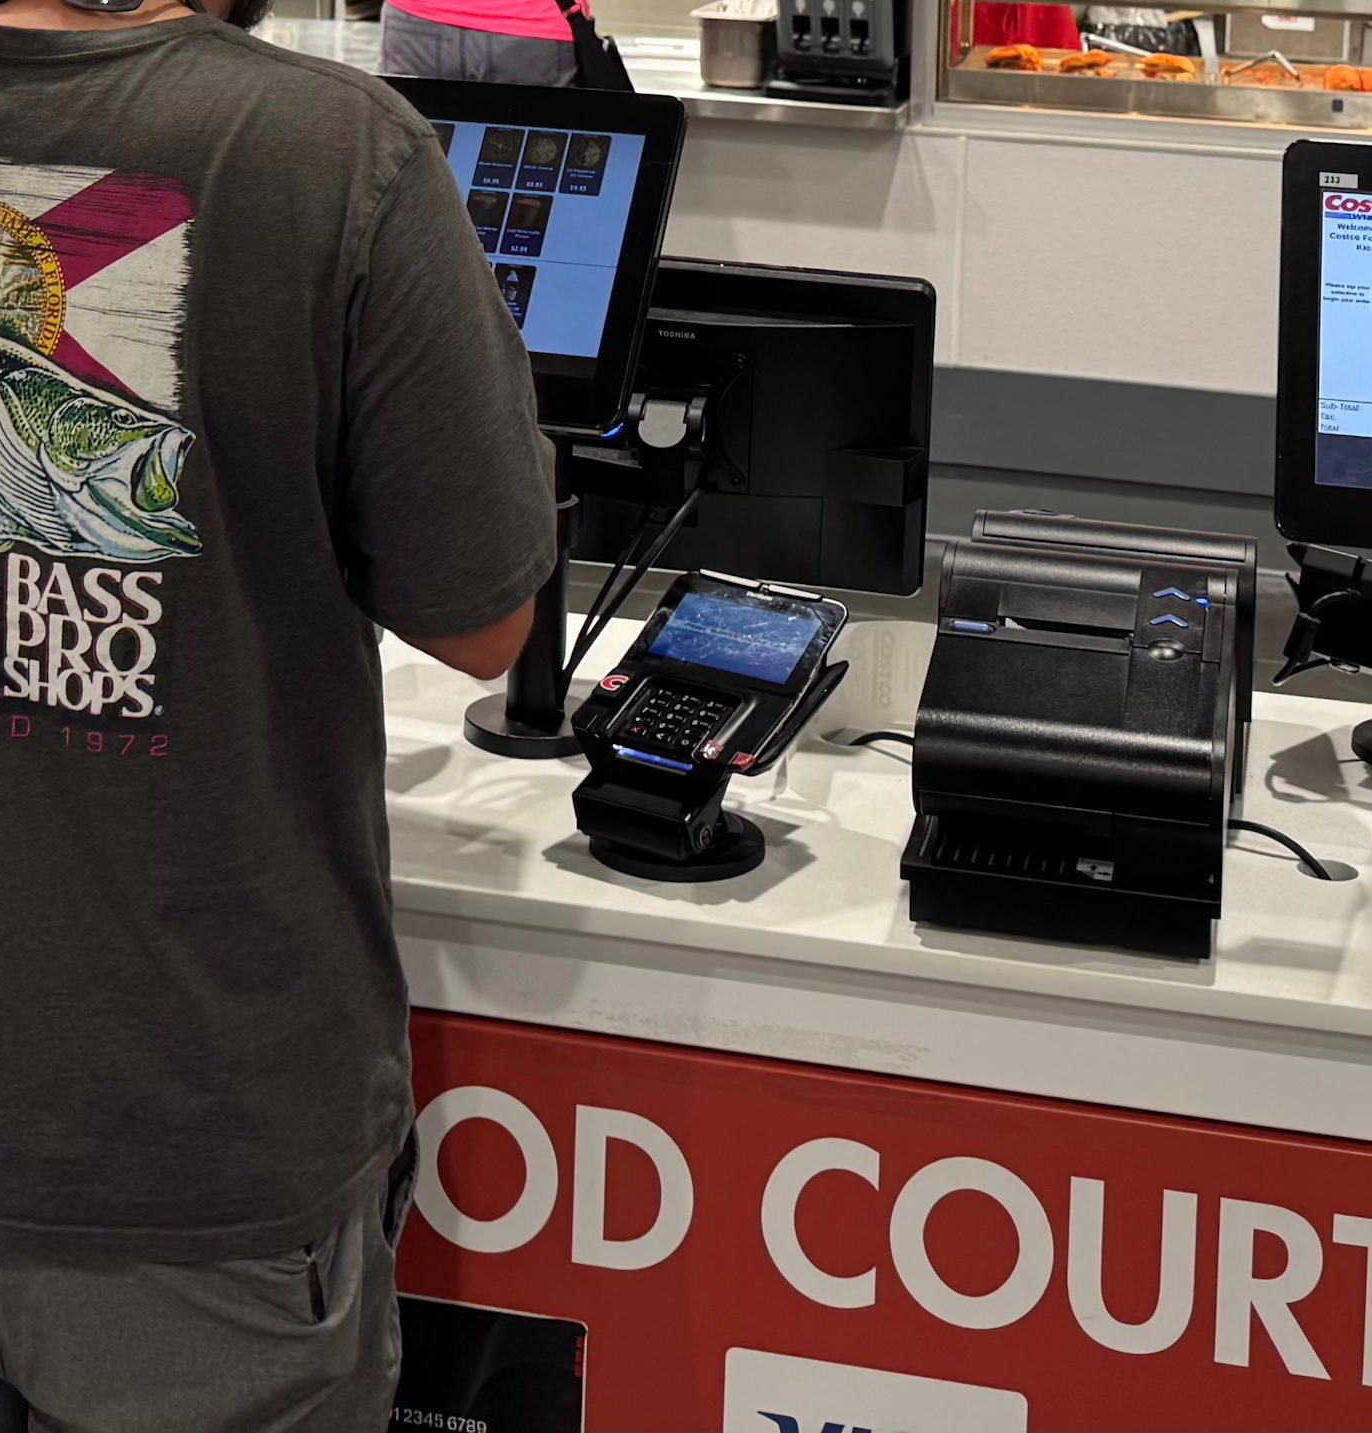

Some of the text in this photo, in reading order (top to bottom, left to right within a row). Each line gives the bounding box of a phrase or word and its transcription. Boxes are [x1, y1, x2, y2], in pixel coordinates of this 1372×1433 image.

[1330, 233, 1360, 241] Costco
[38, 272, 61, 352] FLORIDA
[659, 330, 696, 340] TOSHIBA
[9, 552, 163, 627] BASS
[9, 602, 158, 680] PRO
[60, 725, 171, 757] 1972
[414, 1084, 695, 1271] OD
